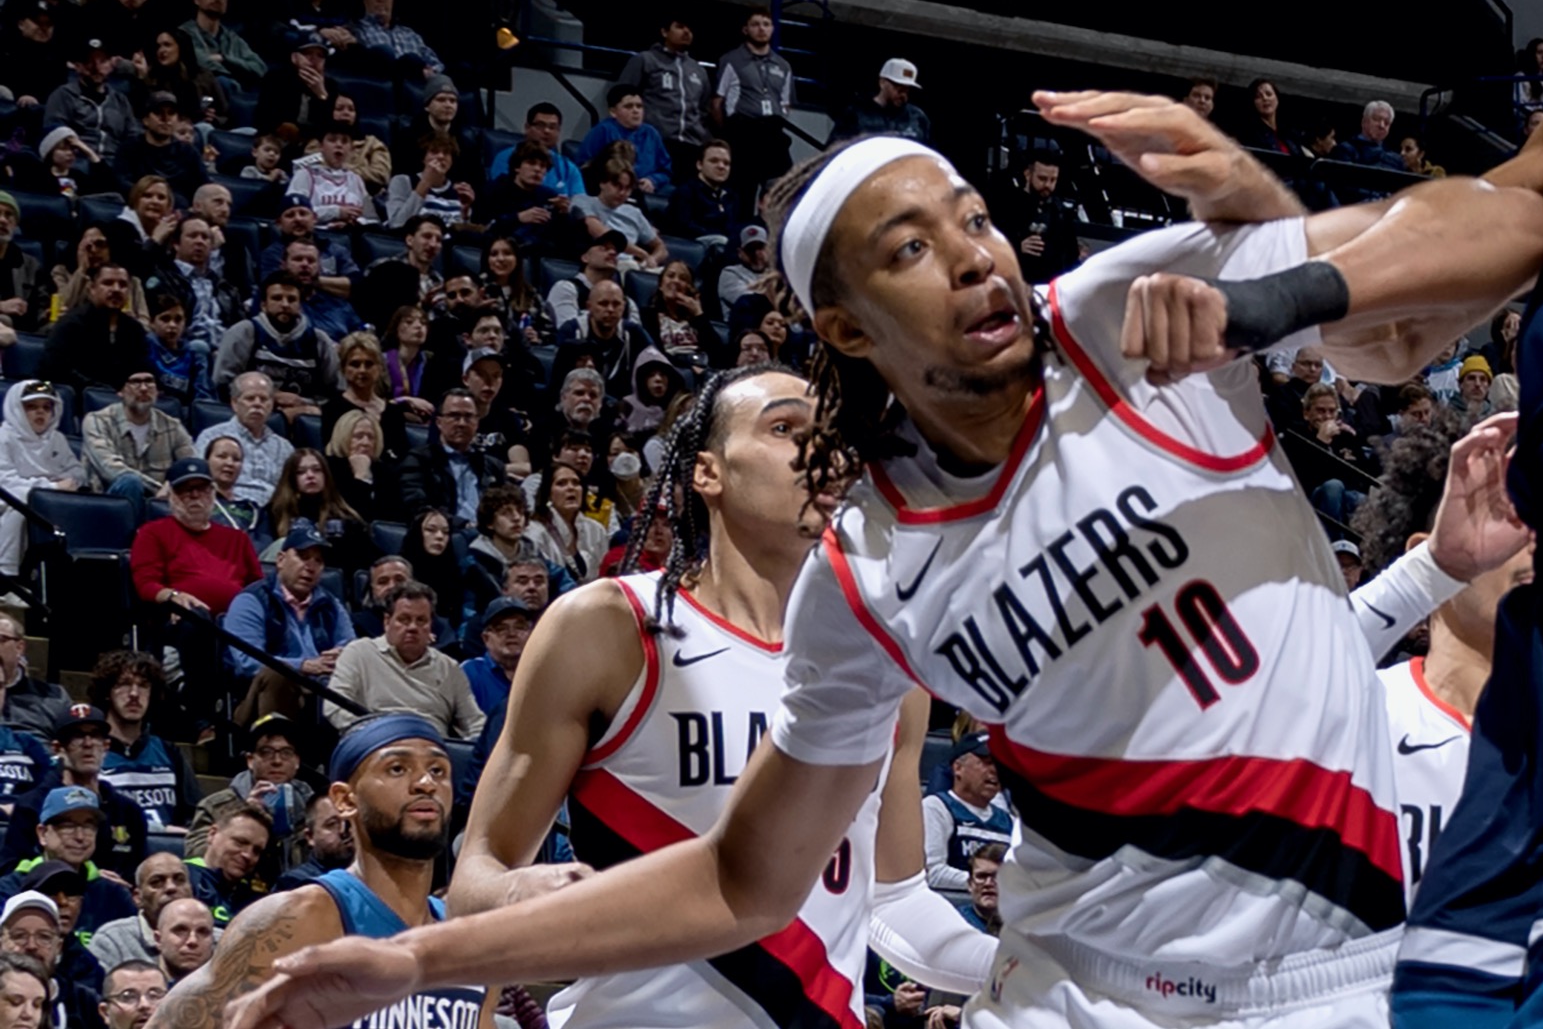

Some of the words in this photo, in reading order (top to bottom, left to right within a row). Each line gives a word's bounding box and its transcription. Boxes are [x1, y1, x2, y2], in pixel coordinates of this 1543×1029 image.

[933, 484, 1189, 715] BLAZERS
[1136, 577, 1261, 713] 10
[1145, 971, 1218, 1004] ripcity
